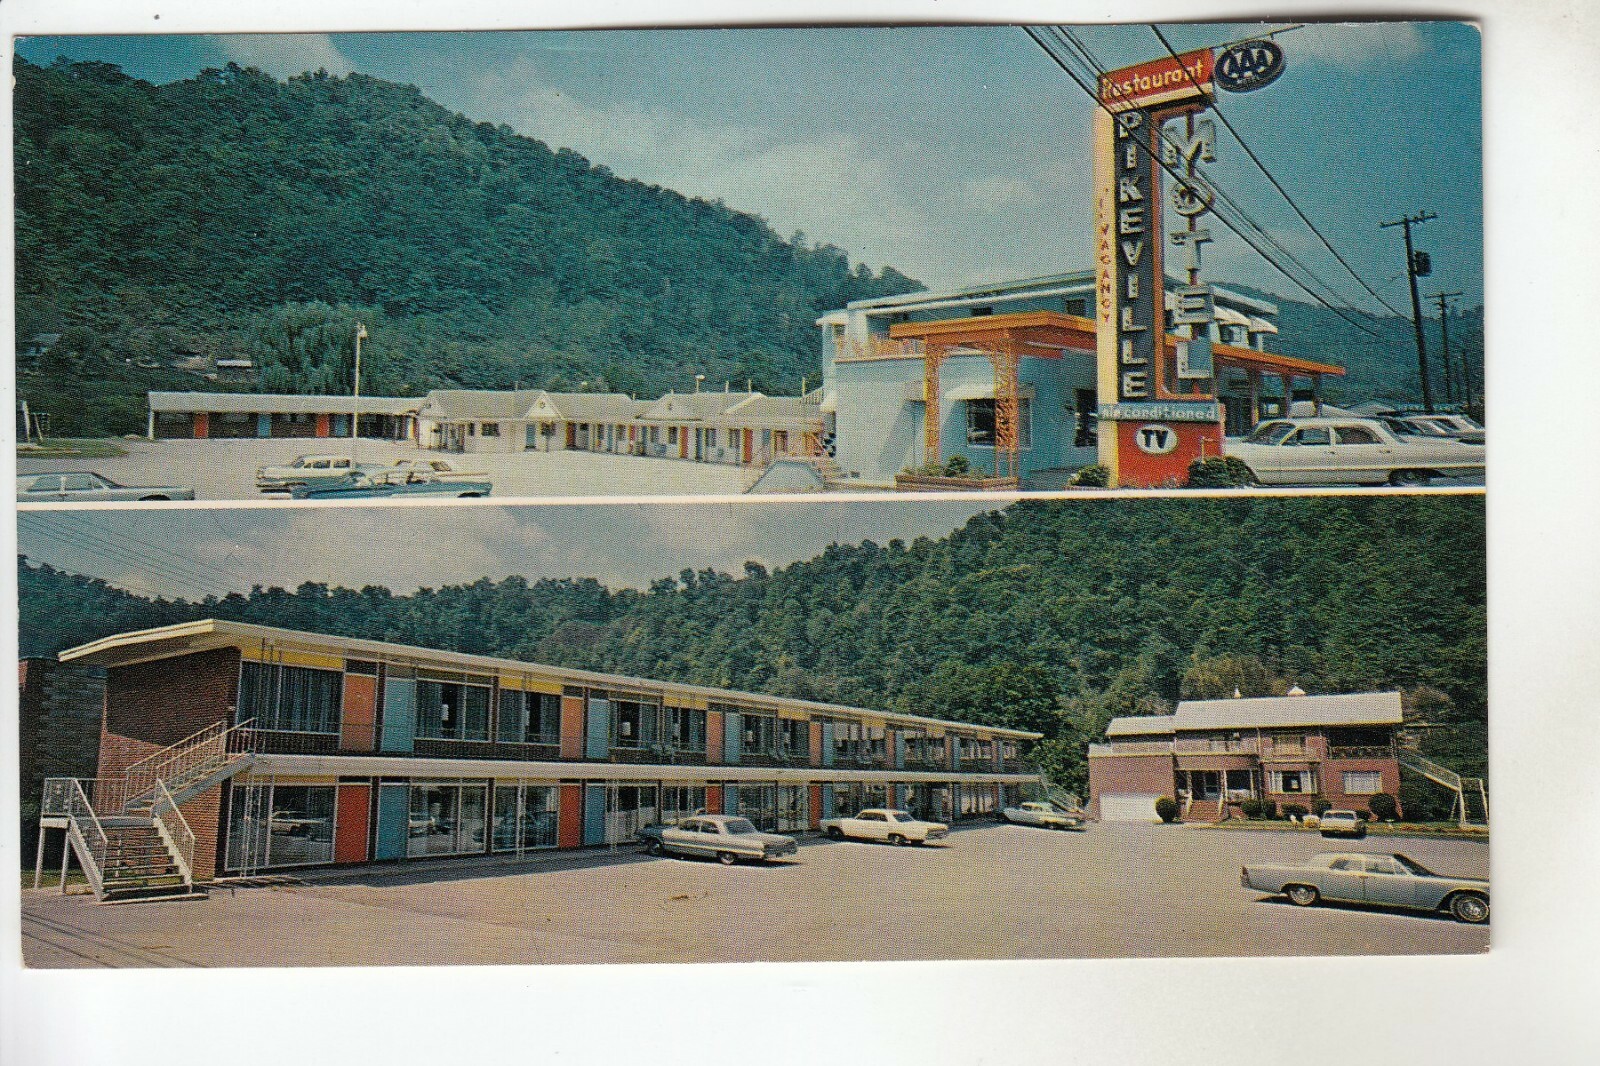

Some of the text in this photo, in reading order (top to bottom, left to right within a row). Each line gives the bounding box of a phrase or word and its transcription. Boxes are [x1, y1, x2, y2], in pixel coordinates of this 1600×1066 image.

[1102, 59, 1204, 99] Restaurant
[1226, 48, 1271, 77] AAA
[1099, 223, 1111, 323] VACANCY
[1119, 111, 1148, 398] PIKEVILLE
[1161, 118, 1215, 379] MOTEL
[1141, 429, 1169, 449] TV
